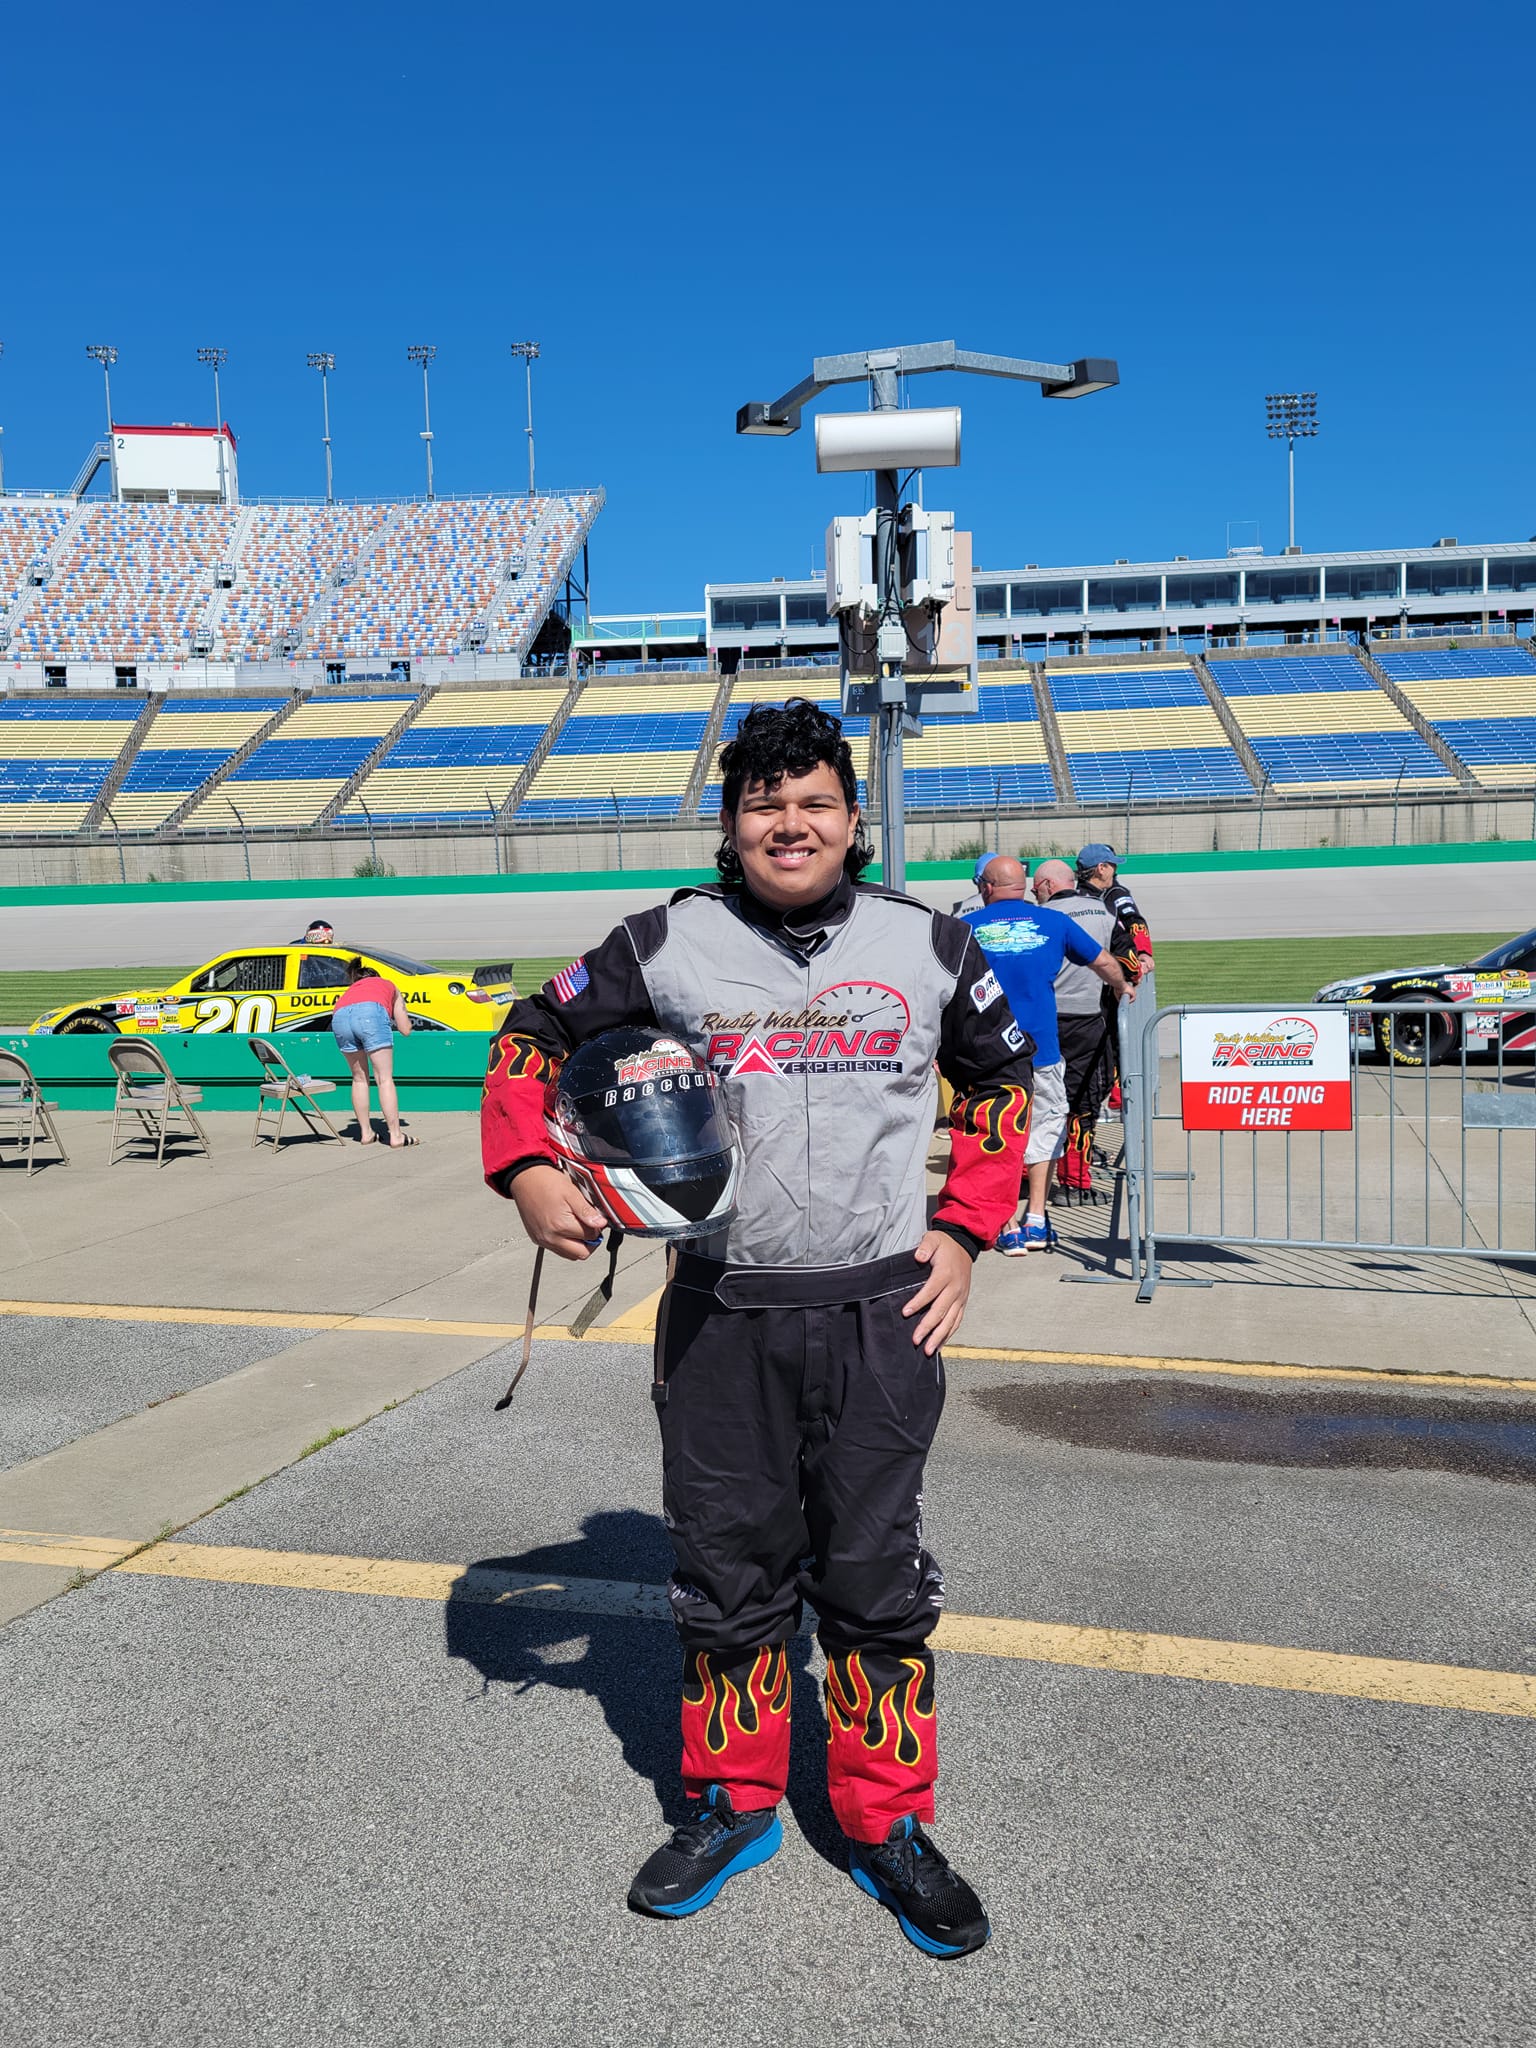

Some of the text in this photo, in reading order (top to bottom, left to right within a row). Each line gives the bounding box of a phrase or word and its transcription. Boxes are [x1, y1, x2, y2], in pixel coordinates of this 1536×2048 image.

[117, 438, 125, 449] 2
[917, 620, 968, 664] 13
[1391, 978, 1439, 989] GOODYEAR
[1452, 981, 1472, 992] 3M
[116, 1003, 134, 1014] 3M
[290, 995, 341, 1007] DOLLA
[194, 995, 277, 1033] 20
[701, 1009, 849, 1035] Rusty Wallace
[59, 1016, 107, 1035] OODYEAR
[708, 1029, 902, 1062] RACING
[1213, 1043, 1314, 1060] RACING
[620, 1056, 692, 1082] RACING
[791, 1060, 899, 1074] EXPERIENCE
[1208, 1086, 1325, 1105] RIDE ALONG
[1240, 1107, 1293, 1126] HERE
